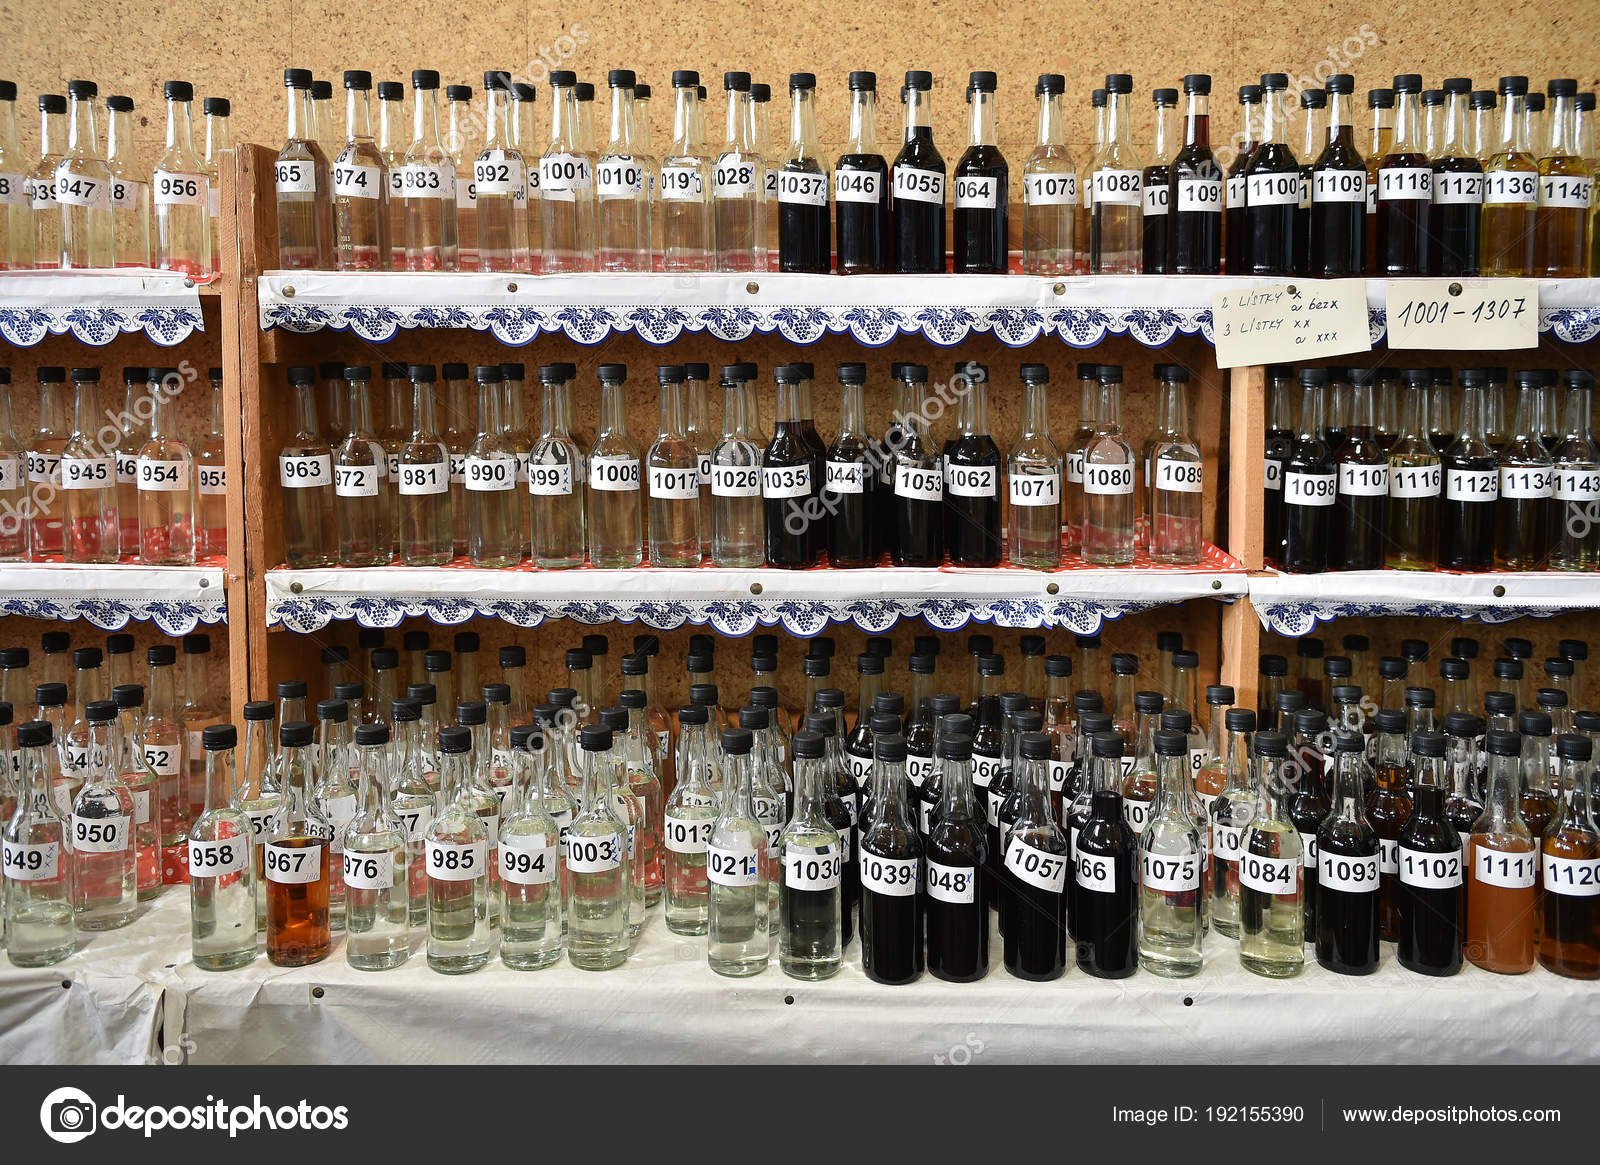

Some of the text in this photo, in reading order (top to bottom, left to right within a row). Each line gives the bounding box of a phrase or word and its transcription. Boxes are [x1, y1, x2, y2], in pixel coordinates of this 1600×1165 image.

[336, 167, 368, 188] 974
[406, 171, 440, 189] 983
[477, 165, 509, 182] 992
[543, 162, 585, 180] 1001
[597, 166, 637, 186] 1010
[661, 167, 689, 189] 019
[60, 177, 95, 199] 947
[160, 178, 197, 197] 956
[780, 175, 822, 197] 1037
[898, 172, 941, 194] 1055
[957, 179, 990, 199] 064
[1034, 177, 1076, 197] 1073
[1097, 174, 1140, 193] 1082
[1253, 176, 1298, 197] 1100
[1317, 175, 1362, 193] 1109
[1383, 170, 1428, 192] 1118
[1440, 177, 1482, 196] 1127
[1486, 176, 1532, 195] 1136
[1148, 188, 1168, 206] 10
[1545, 182, 1588, 201] 1145
[1224, 323, 1231, 337] 3
[28, 456, 59, 475] 937
[70, 462, 107, 481] 945
[116, 459, 136, 475] 46
[143, 464, 178, 483] 954
[285, 460, 321, 479] 963
[471, 463, 505, 482] 990
[596, 464, 638, 483] 1008
[827, 466, 856, 483] 044
[1164, 464, 1202, 485] 1089
[336, 470, 365, 488] 972
[403, 468, 436, 487] 981
[530, 468, 559, 487] 999
[654, 471, 696, 490] 1017
[714, 469, 757, 489] 1026
[764, 469, 805, 489] 1035
[902, 471, 941, 492] 1053
[950, 470, 990, 488] 1062
[1088, 467, 1131, 486] 1080
[1346, 468, 1388, 487] 1107
[1395, 469, 1439, 489] 1116
[1453, 474, 1497, 493] 1125
[1508, 472, 1552, 489] 1134
[1554, 474, 1600, 492] 1143
[1012, 479, 1055, 498] 1071
[1292, 478, 1335, 497] 1098
[145, 750, 168, 767] 52
[910, 760, 931, 777] 05
[77, 824, 116, 843] 950
[1216, 831, 1238, 850] 10
[4, 850, 42, 870] 949
[193, 845, 233, 867] 958
[433, 849, 474, 869] 985
[567, 841, 611, 862] 1003
[268, 851, 306, 873] 967
[344, 858, 378, 878] 976
[505, 852, 545, 873] 994
[794, 856, 839, 880] 1030
[863, 857, 910, 885] 1039
[1014, 848, 1063, 881] 1057
[1076, 852, 1106, 881] 066
[1143, 856, 1194, 881] 1075
[1241, 855, 1290, 883] 1084
[1325, 859, 1376, 882] 1093
[1405, 856, 1458, 878] 1102
[1484, 855, 1533, 878] 1111
[930, 867, 966, 893] 048
[1549, 862, 1600, 885] 1120
